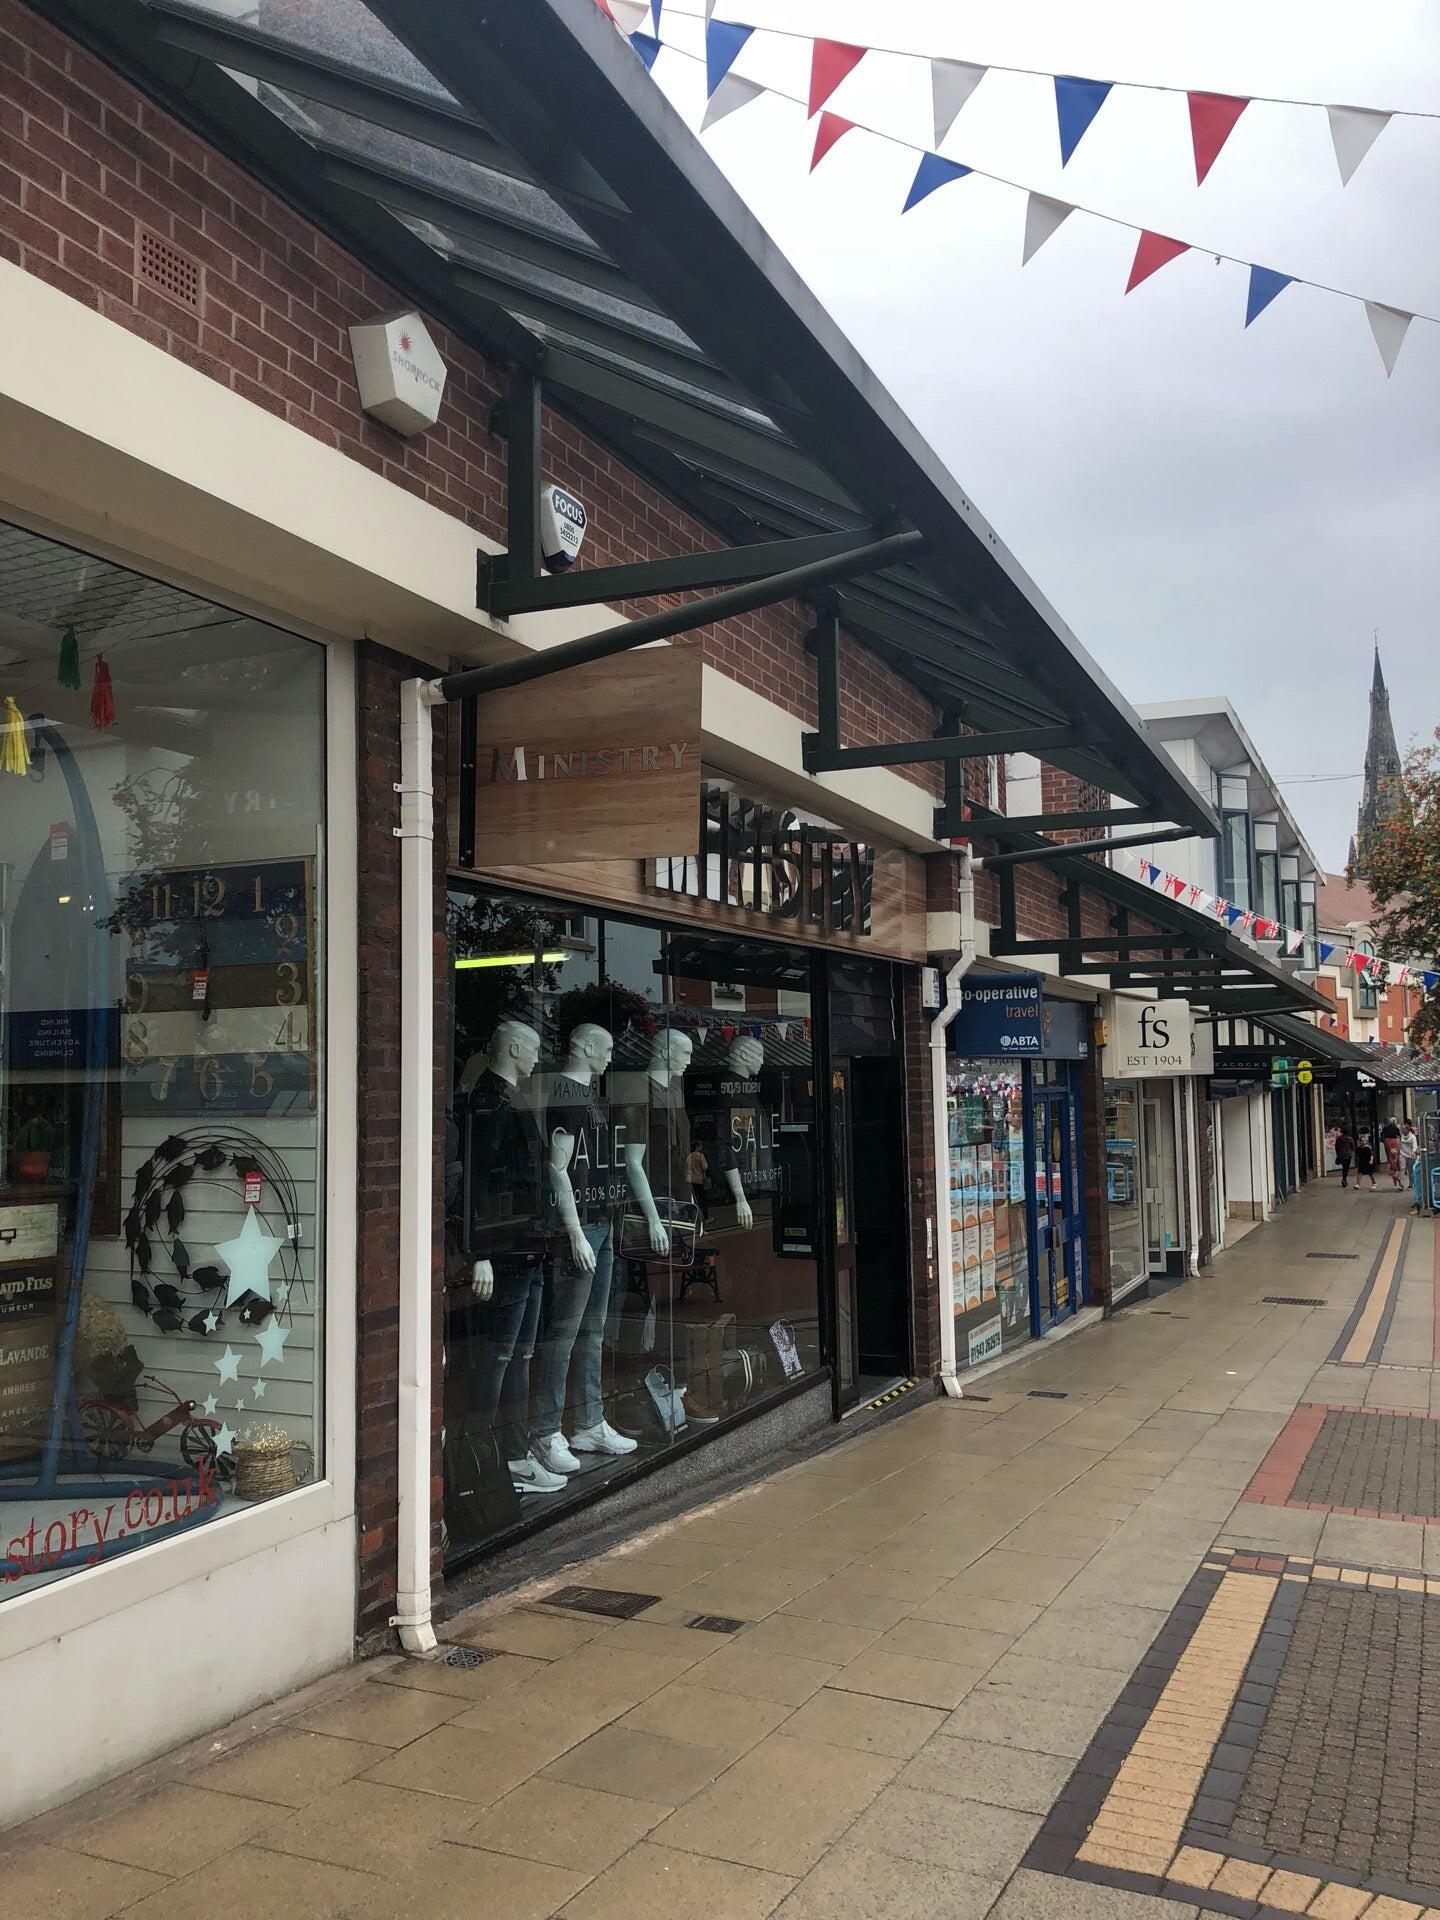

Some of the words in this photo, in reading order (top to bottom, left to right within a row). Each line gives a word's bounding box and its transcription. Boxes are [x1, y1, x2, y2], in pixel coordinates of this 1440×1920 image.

[555, 494, 583, 525] FOCUS
[490, 742, 688, 784] MINISTRY
[192, 876, 225, 917] 12
[252, 875, 266, 913] 1
[275, 962, 301, 1006] 3
[275, 1010, 302, 1051] 4
[1006, 1003, 1039, 1019] travel
[1137, 1006, 1170, 1048] fs
[1011, 1036, 1039, 1046] ABTA
[1127, 1056, 1148, 1066] EST
[1153, 1055, 1183, 1066] 1904
[551, 1125, 627, 1171] SALE
[731, 1113, 780, 1153] SALE
[585, 1186, 606, 1202] 50%
[608, 1184, 627, 1199] OFF
[0, 1455, 217, 1583] story.co.uk
